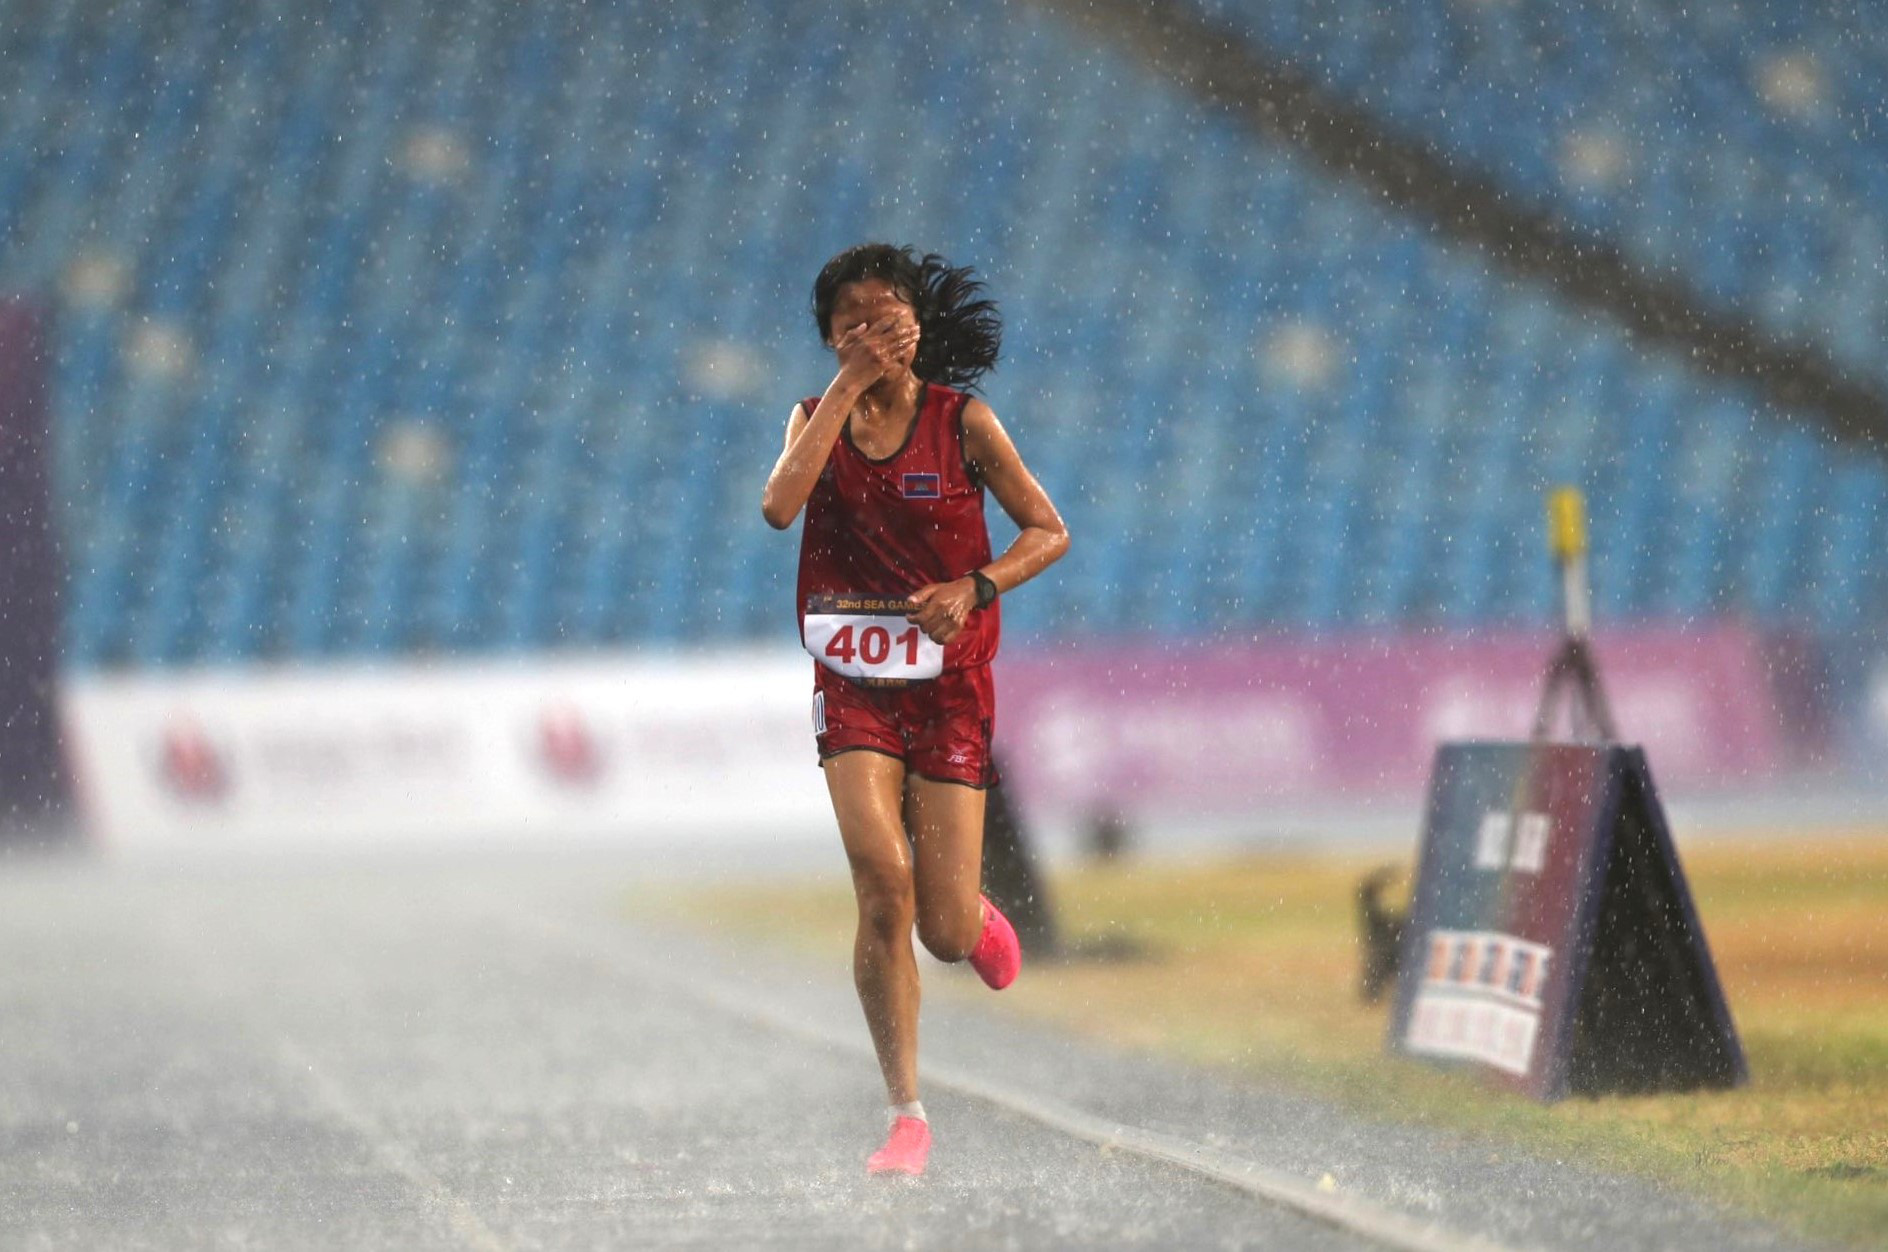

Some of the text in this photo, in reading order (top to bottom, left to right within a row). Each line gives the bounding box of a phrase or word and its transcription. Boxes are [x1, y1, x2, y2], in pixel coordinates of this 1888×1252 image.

[836, 600, 861, 609] 32nd
[864, 600, 885, 609] SEA
[825, 625, 918, 665] 401
